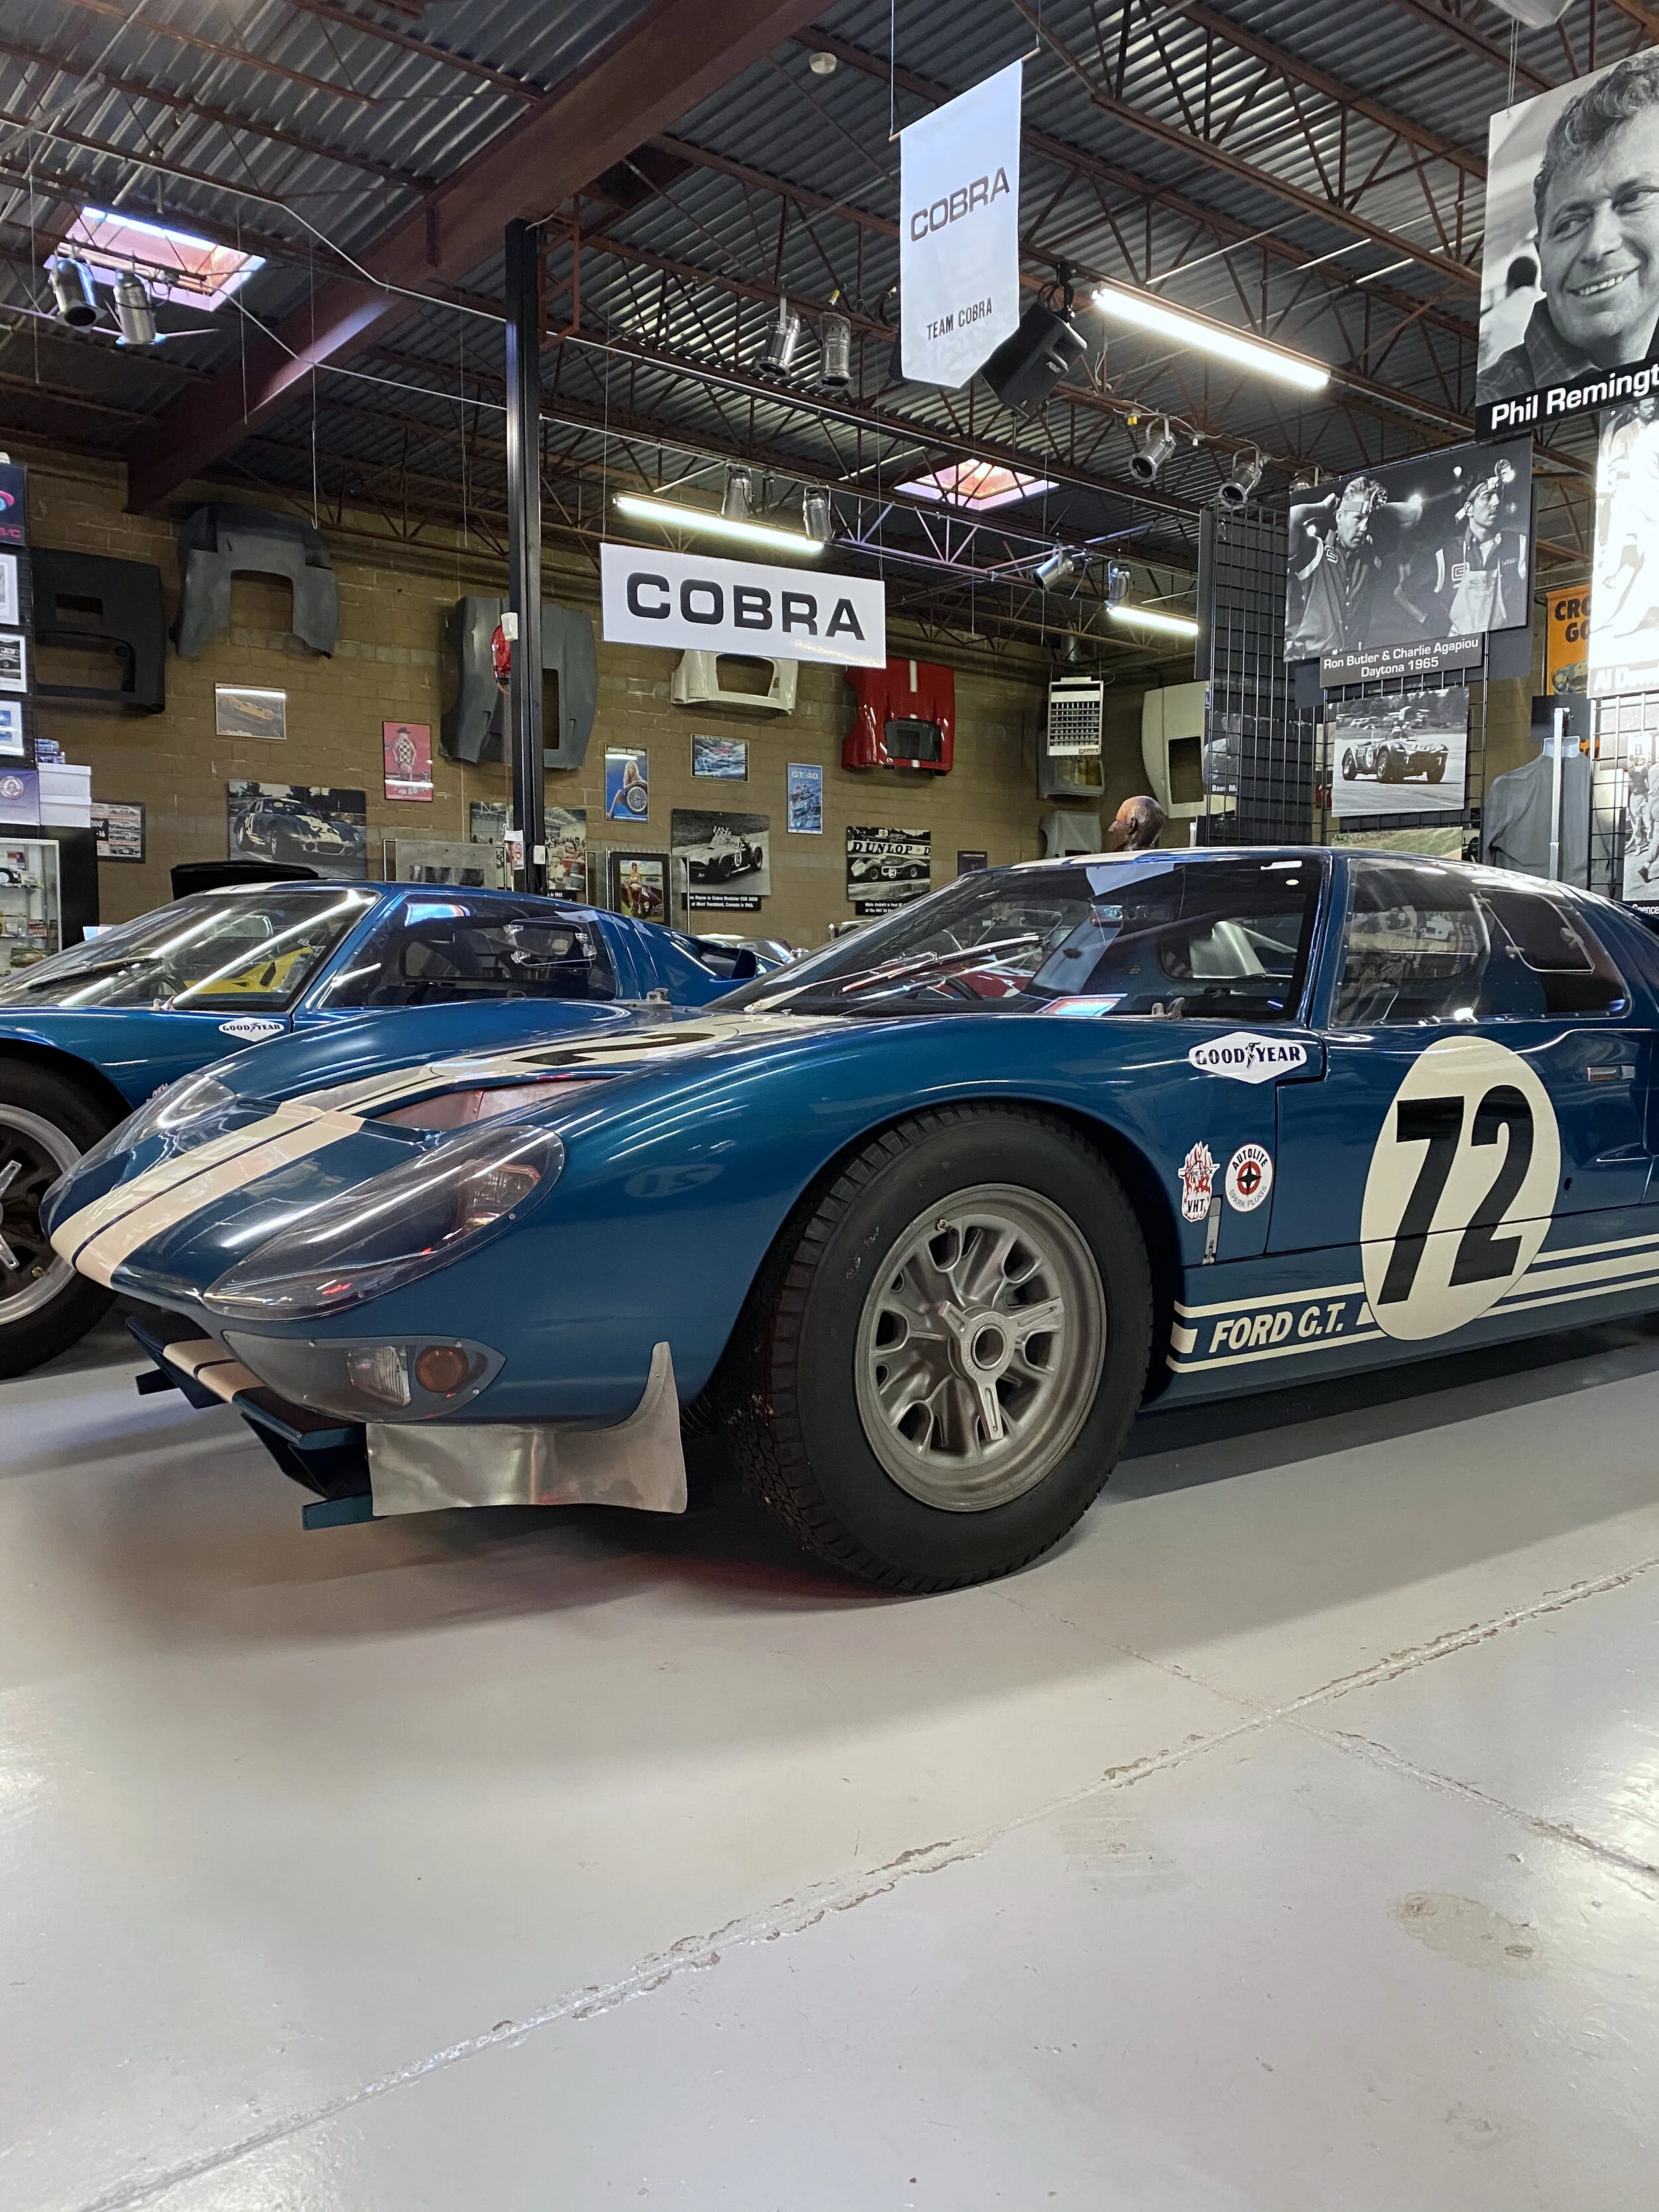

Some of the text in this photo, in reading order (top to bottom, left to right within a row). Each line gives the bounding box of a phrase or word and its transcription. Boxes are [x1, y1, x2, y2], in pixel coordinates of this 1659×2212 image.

[910, 166, 1010, 242] COBRA
[927, 297, 993, 342] TEAM COBRA
[1491, 363, 1659, 430] Phil Remingt
[626, 571, 866, 642] COBRA
[1324, 638, 1479, 670] Ron Butler & Charlie Agapiou
[1361, 656, 1439, 678] Daytona 1965
[852, 841, 912, 855] DUNLOP
[1232, 1148, 1268, 1171] AUTOLITE
[1188, 1199, 1205, 1213] VHT
[1228, 1185, 1267, 1208] SPARK PLUGS
[1377, 1084, 1534, 1305] 72
[1208, 1302, 1345, 1353] FORD G.T.
